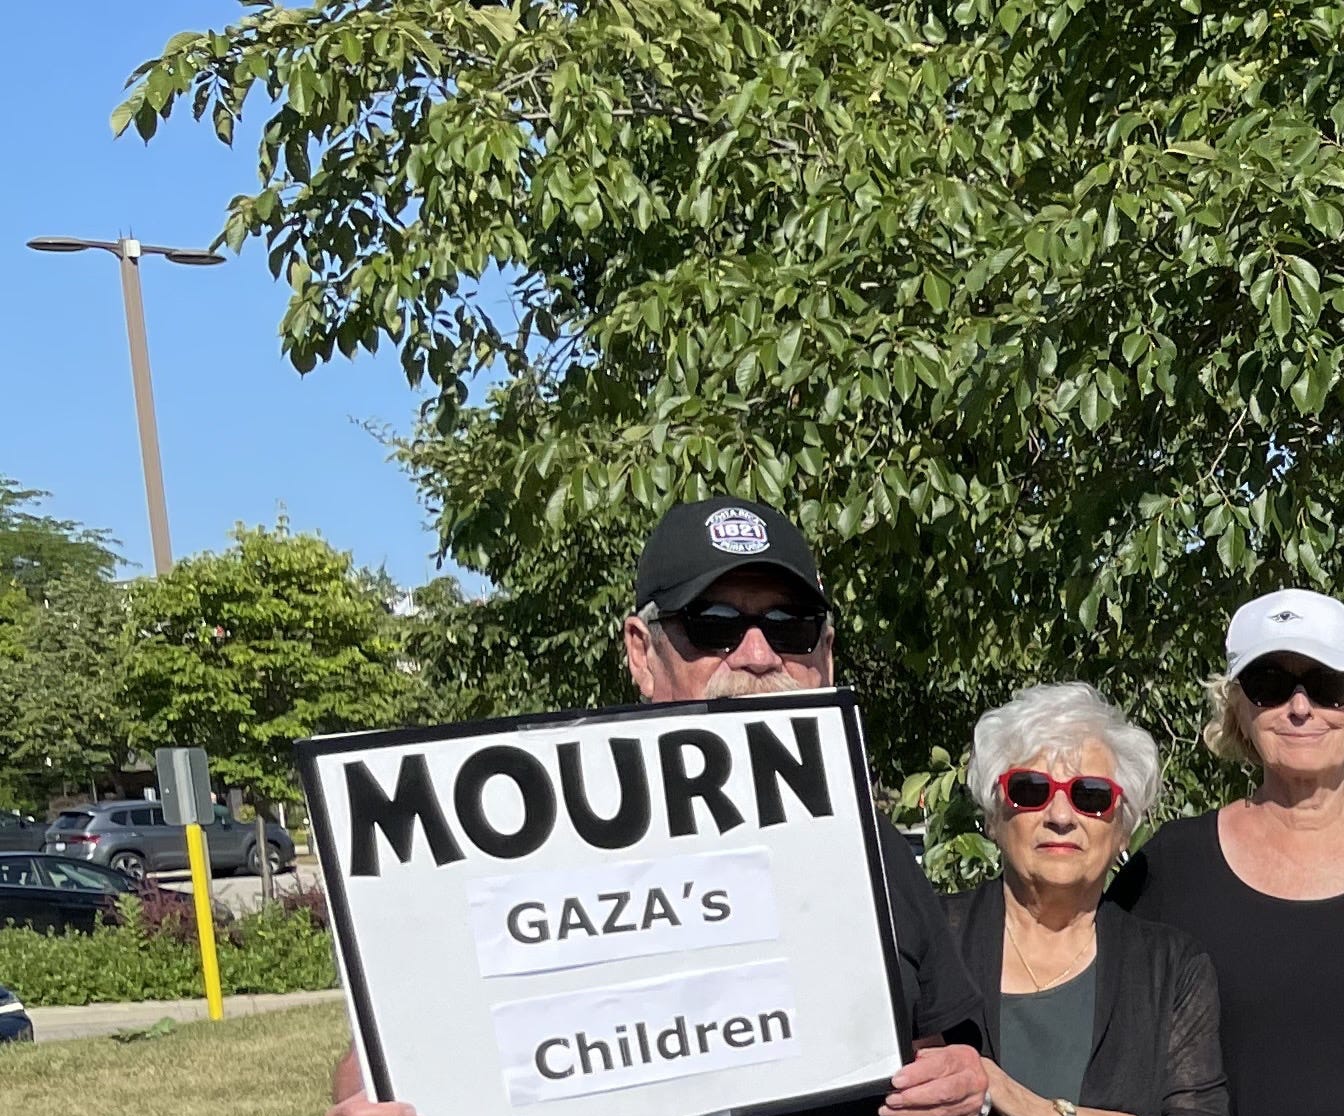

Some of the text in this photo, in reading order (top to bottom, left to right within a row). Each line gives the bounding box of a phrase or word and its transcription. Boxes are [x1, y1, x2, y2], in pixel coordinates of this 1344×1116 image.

[713, 524, 763, 538] 1821
[342, 716, 836, 878] MOURN
[506, 881, 732, 945] GAZA's
[534, 1007, 794, 1081] Children
